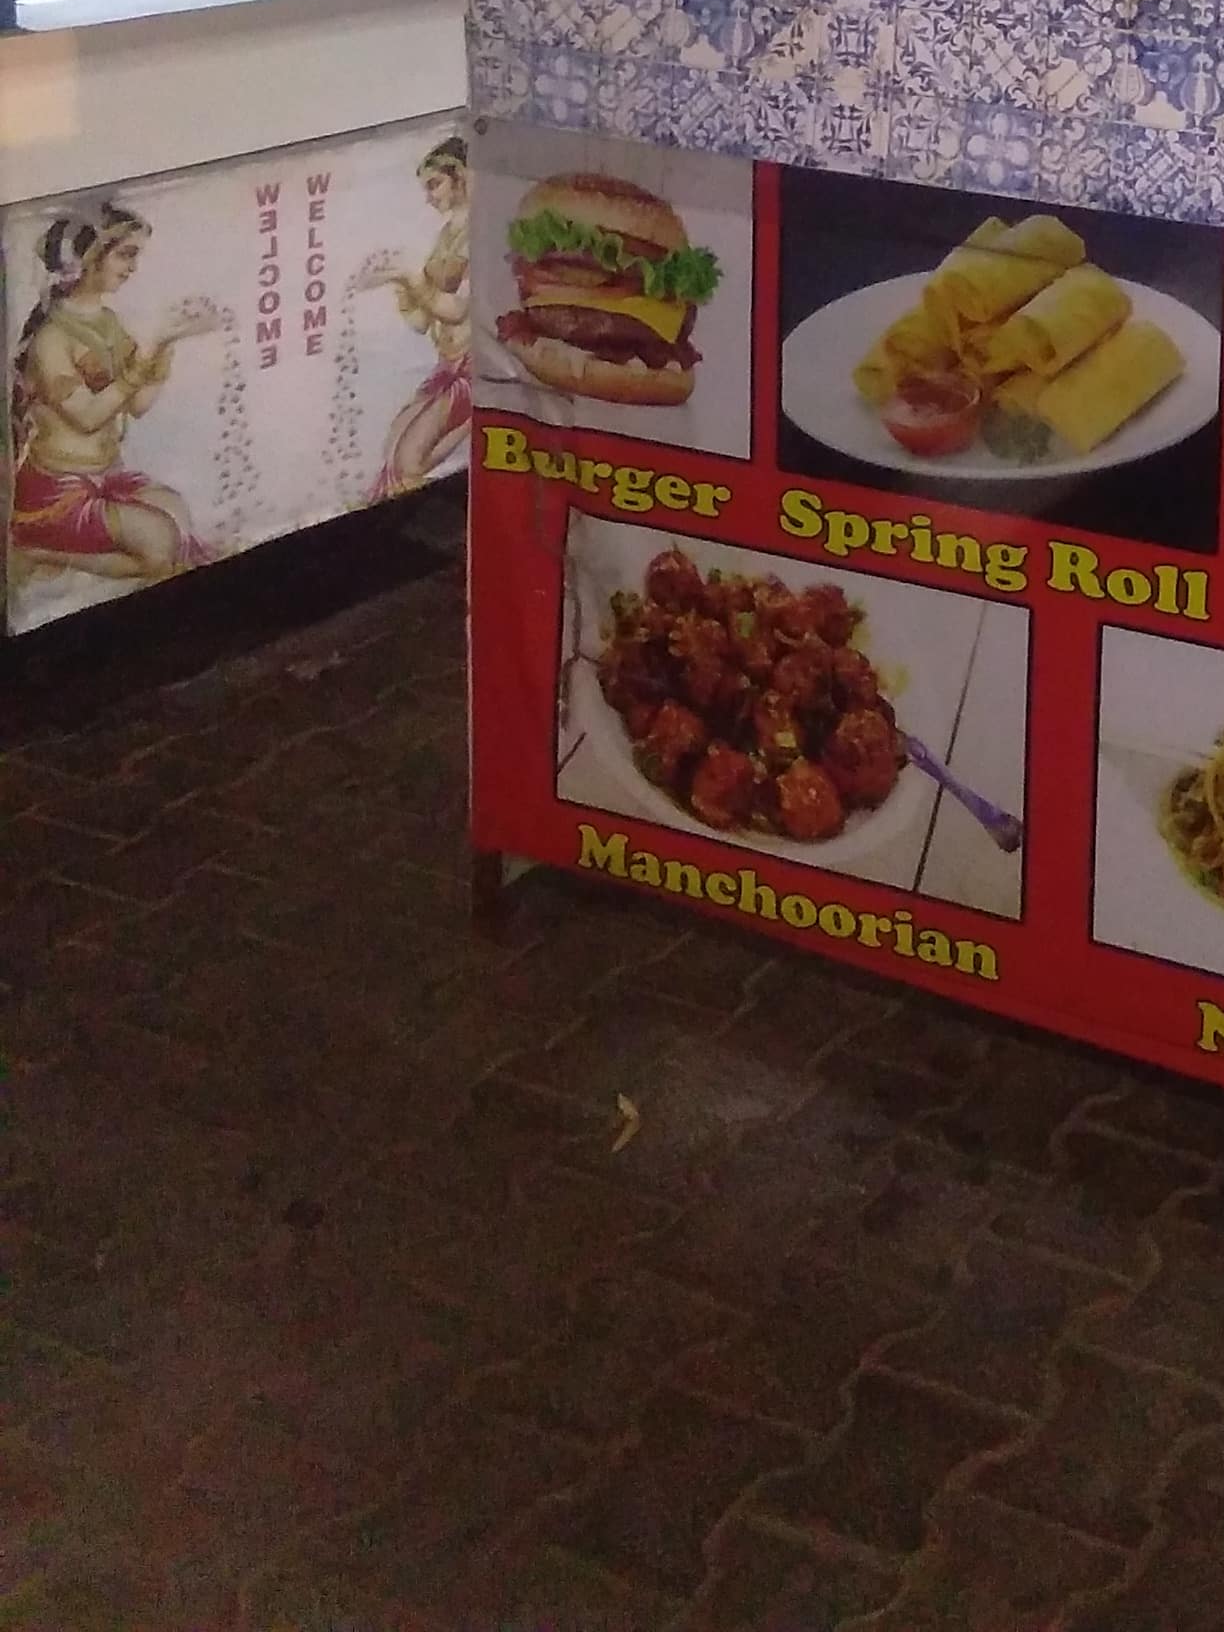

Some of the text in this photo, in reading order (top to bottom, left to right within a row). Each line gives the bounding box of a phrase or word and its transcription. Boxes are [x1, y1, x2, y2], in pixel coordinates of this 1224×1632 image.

[304, 171, 333, 357] WELCOME
[482, 425, 732, 517] Burger
[779, 489, 1210, 620] Spring Roll
[577, 825, 1000, 981] Manchoorian
